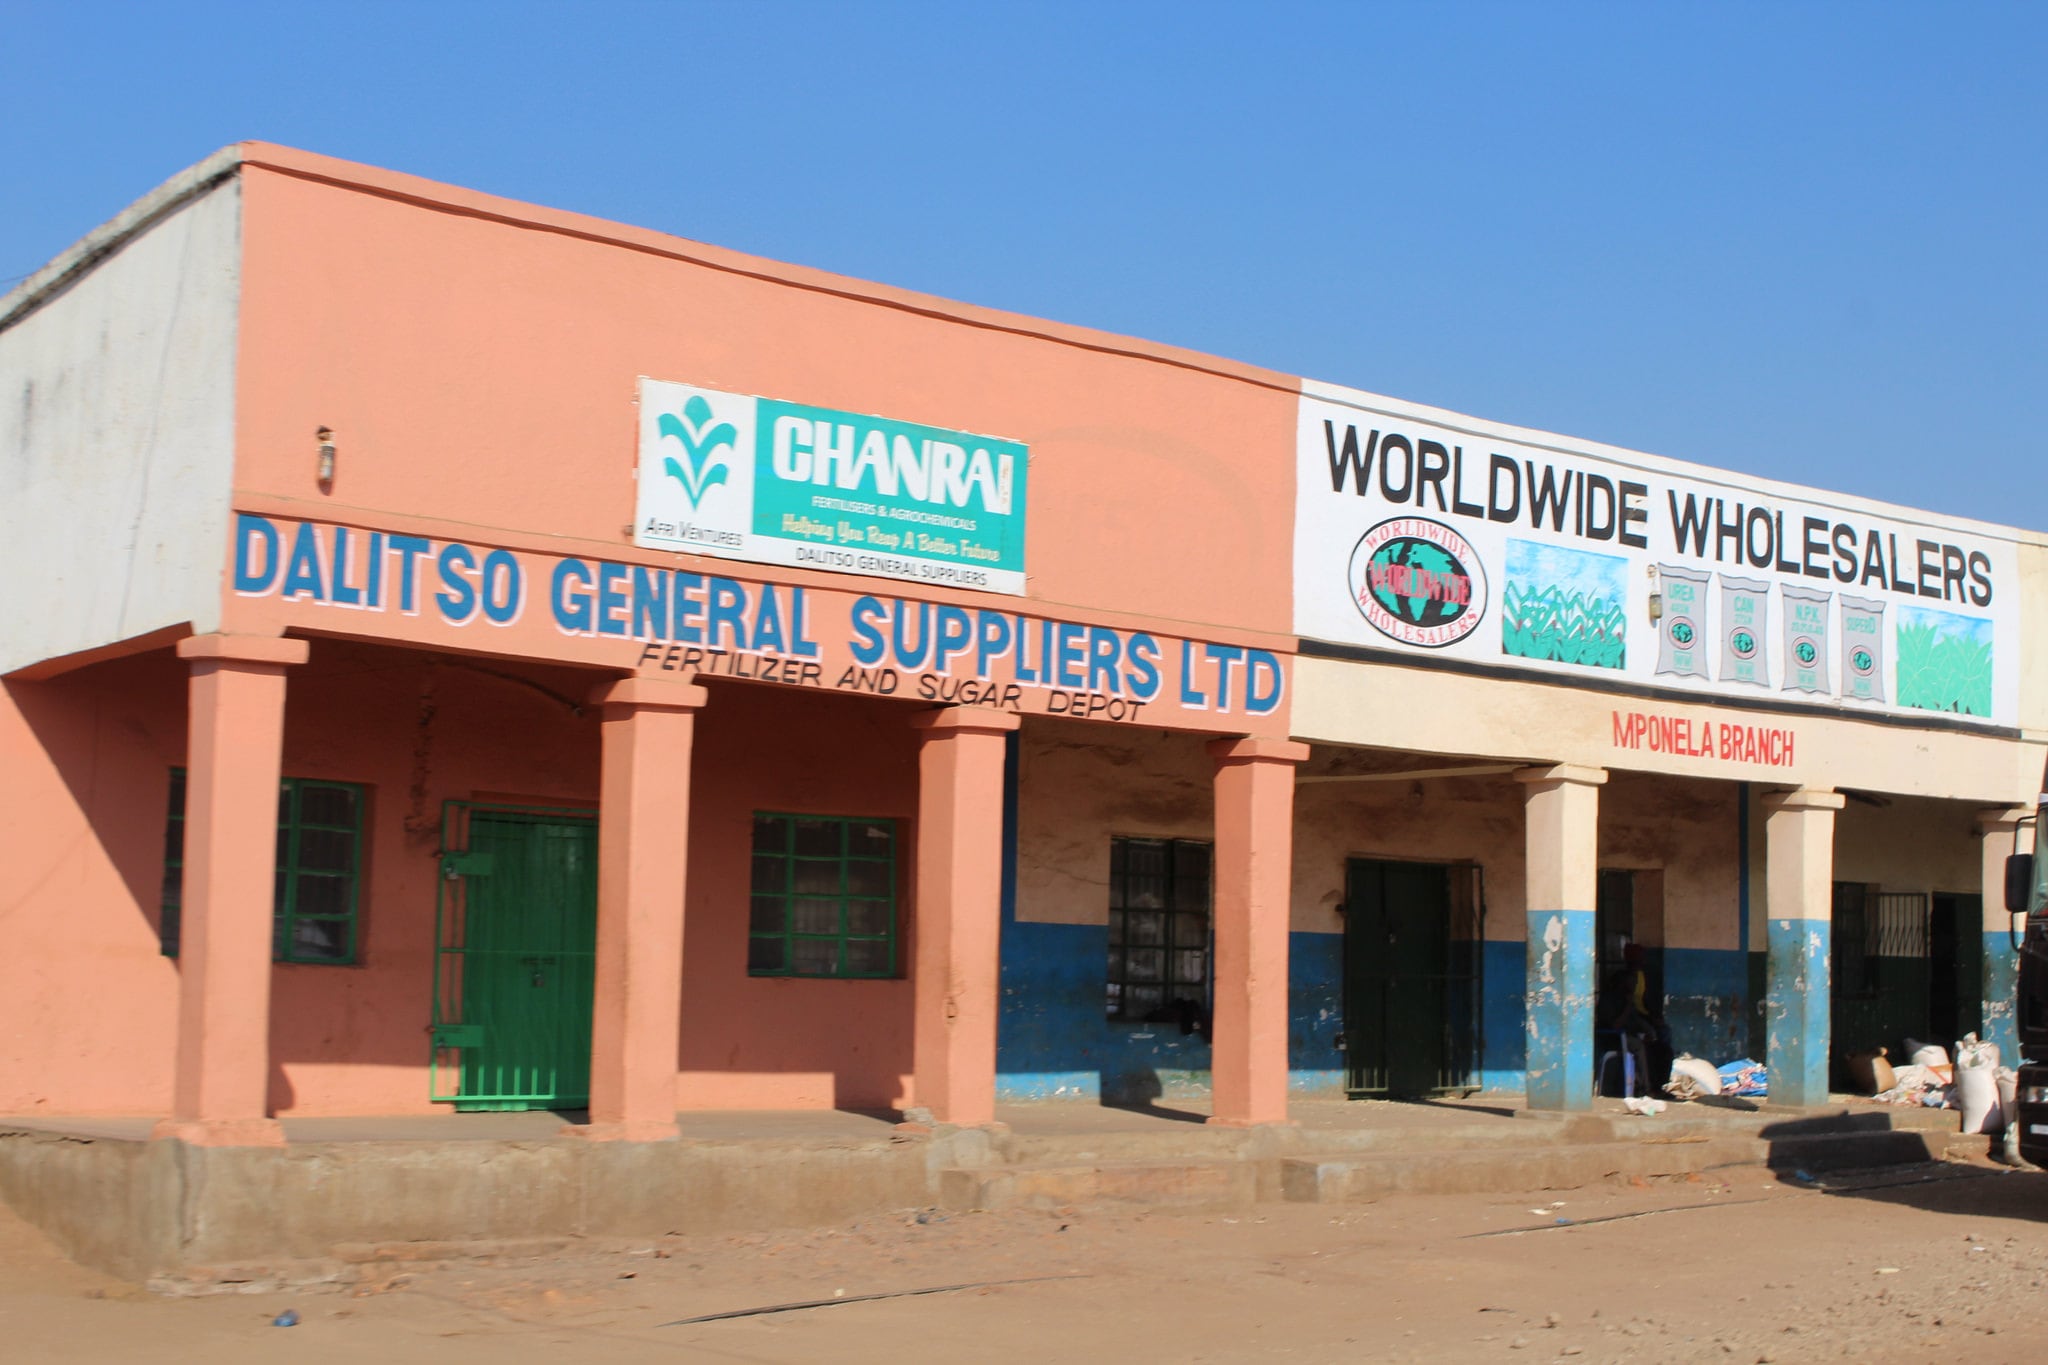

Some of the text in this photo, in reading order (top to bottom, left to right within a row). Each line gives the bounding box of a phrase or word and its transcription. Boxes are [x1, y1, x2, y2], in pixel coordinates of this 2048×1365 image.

[772, 415, 1013, 516] CHANRAI
[678, 521, 743, 547] VENTURES
[877, 506, 888, 517] &
[1325, 419, 1993, 608] WORLDWIDE WHOLESALERS
[781, 512, 1001, 563] Helping You Reap A Better Future
[1365, 520, 1470, 563] WORLDWIDE
[795, 546, 989, 586] DALITSO GENERAL SUPPLIERS
[1368, 560, 1471, 606] WORLDWIDE
[233, 513, 1286, 716] DALITSO GENERAL SUPPLIERS LTD
[1358, 587, 1478, 644] WHOLESALERS
[1668, 583, 1695, 602] UREA
[1734, 596, 1755, 614] CAN
[637, 643, 1147, 722] FERTILIZER AND SUGAR DEPOT
[1612, 710, 1794, 767] MPONELA BRANCH
